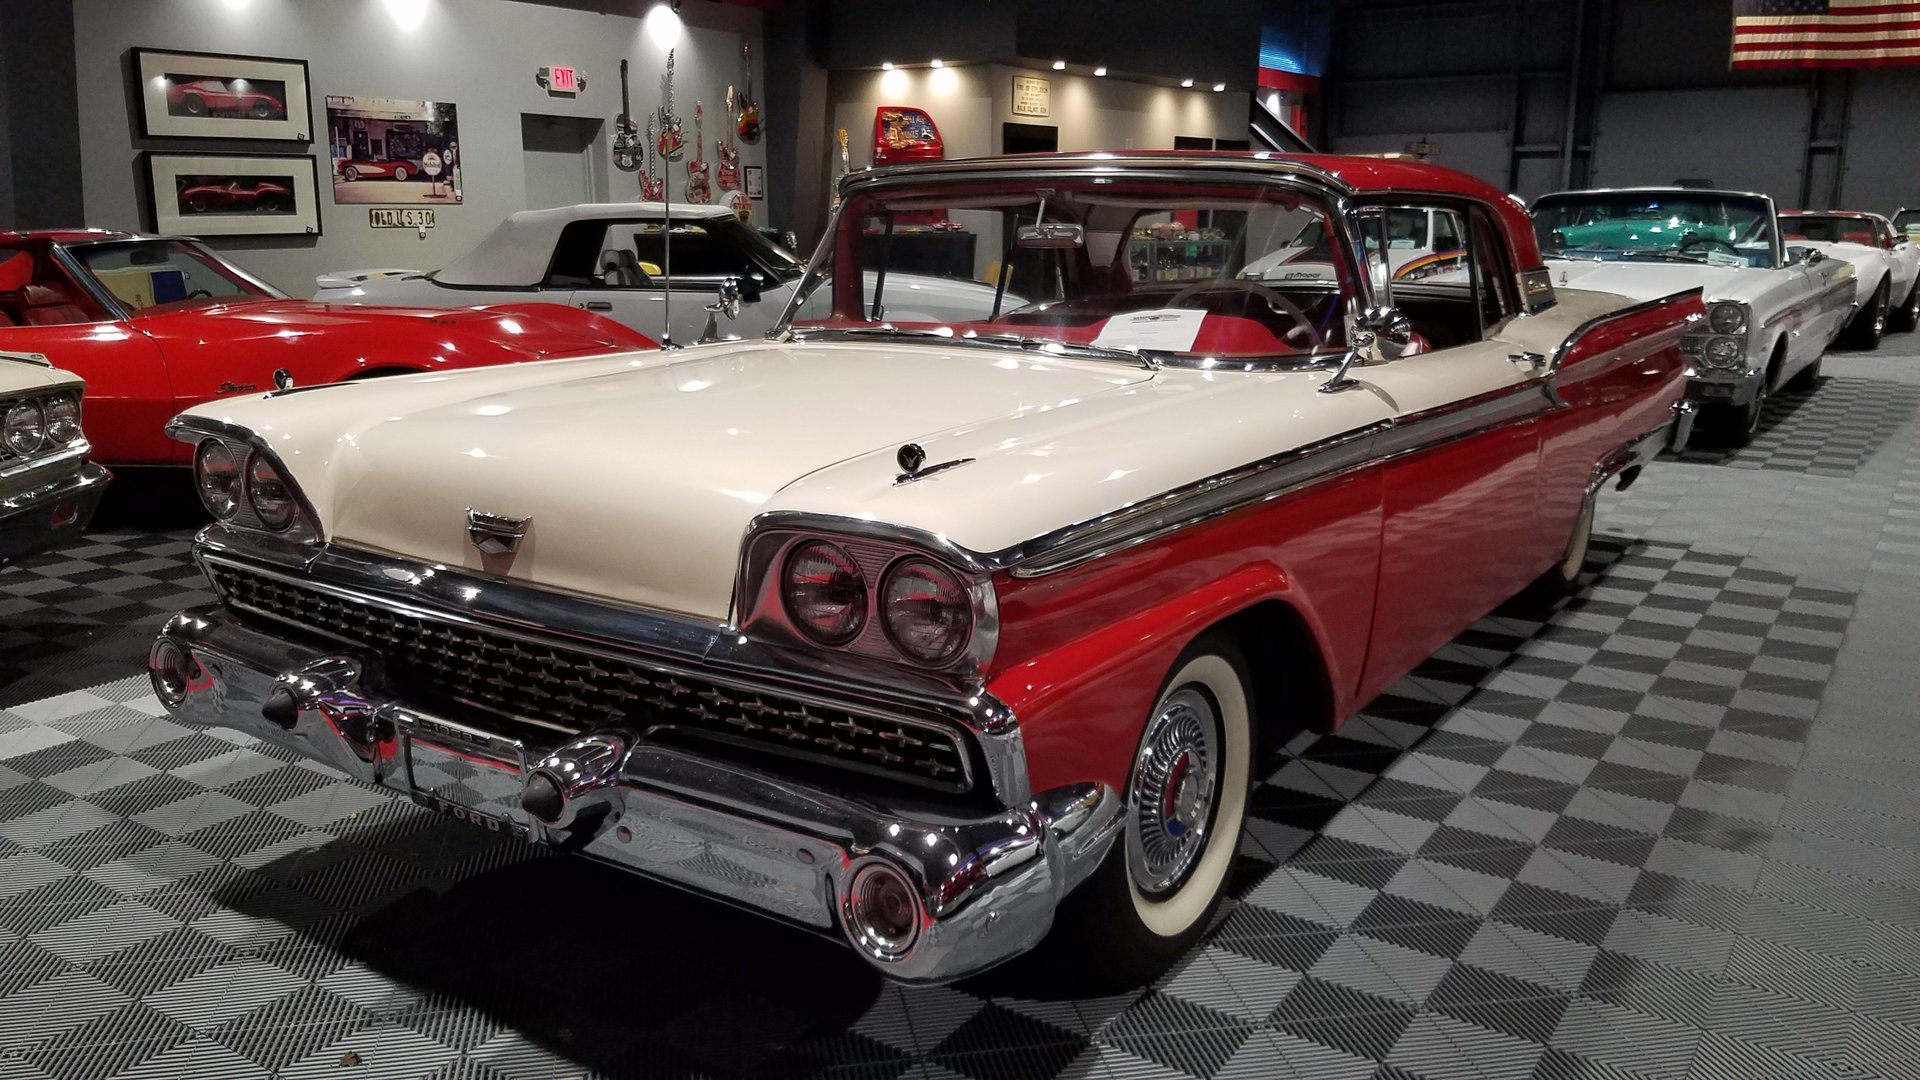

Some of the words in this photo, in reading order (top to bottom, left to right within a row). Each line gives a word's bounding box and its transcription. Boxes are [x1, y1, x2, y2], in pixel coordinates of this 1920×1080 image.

[554, 67, 574, 88] EXIT
[375, 211, 393, 225] OLD
[418, 211, 431, 225] 30
[438, 801, 500, 832] FORD
